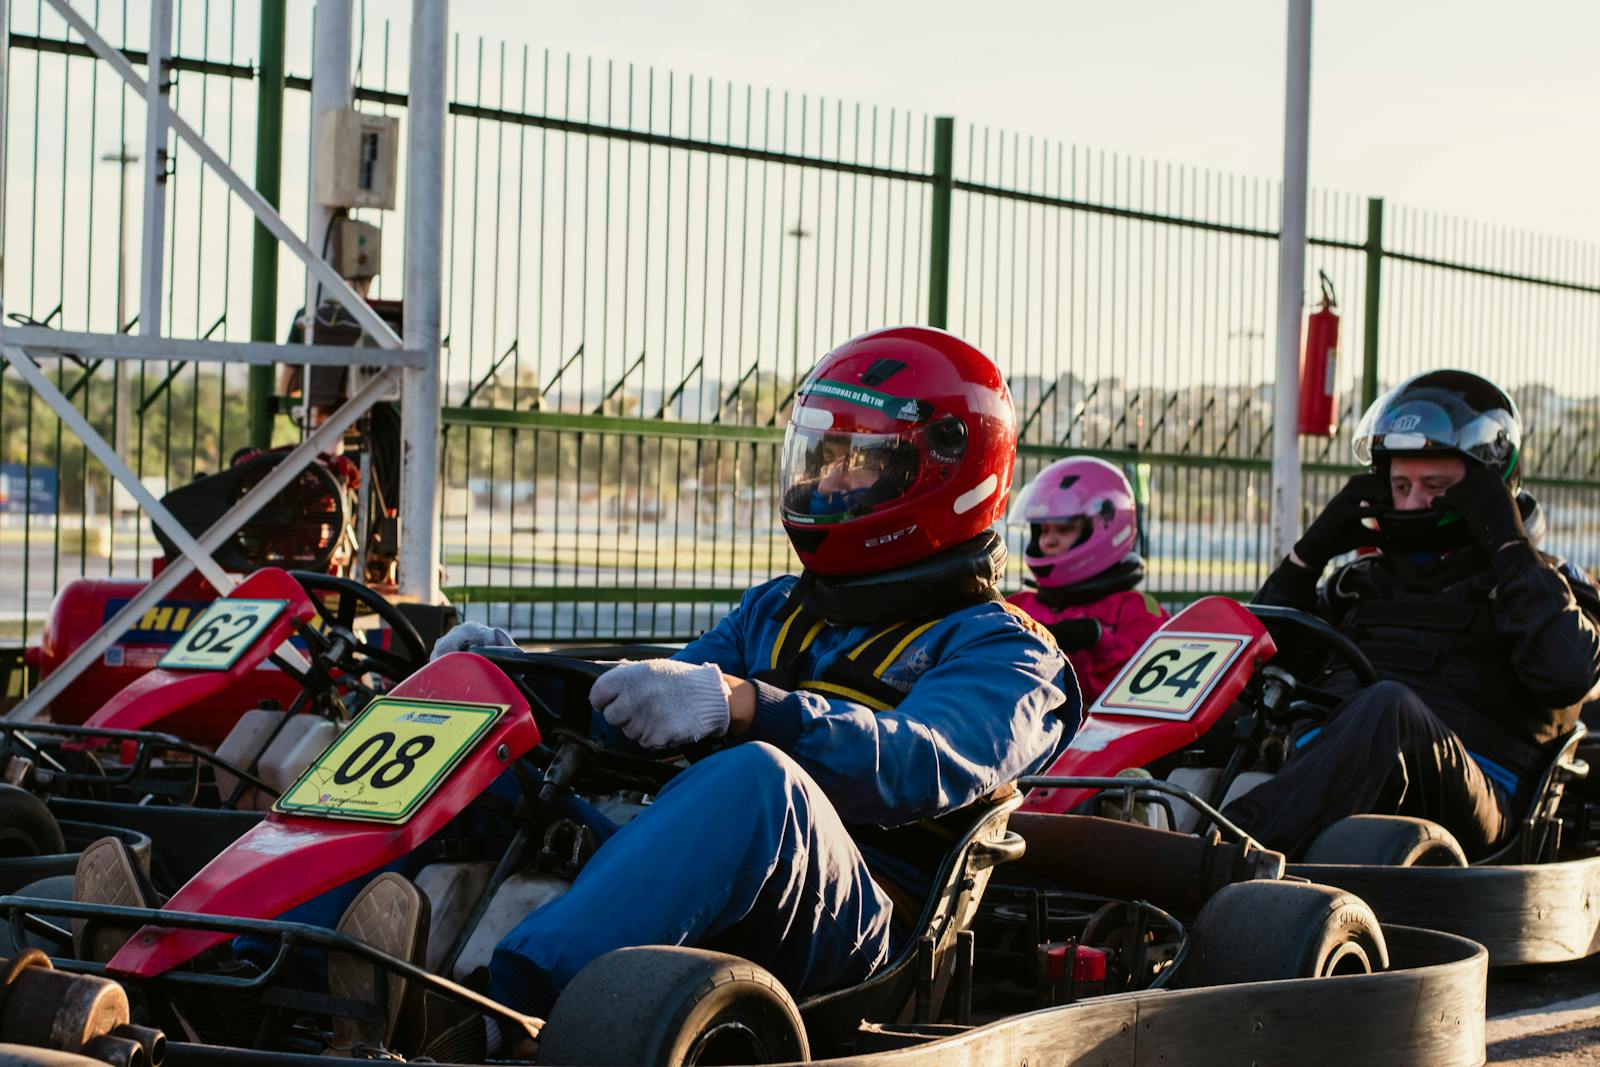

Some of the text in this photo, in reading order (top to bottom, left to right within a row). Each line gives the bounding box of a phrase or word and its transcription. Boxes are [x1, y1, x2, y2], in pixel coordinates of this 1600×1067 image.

[186, 613, 259, 652] 62
[1129, 649, 1218, 698] 64
[333, 732, 435, 789] 08
